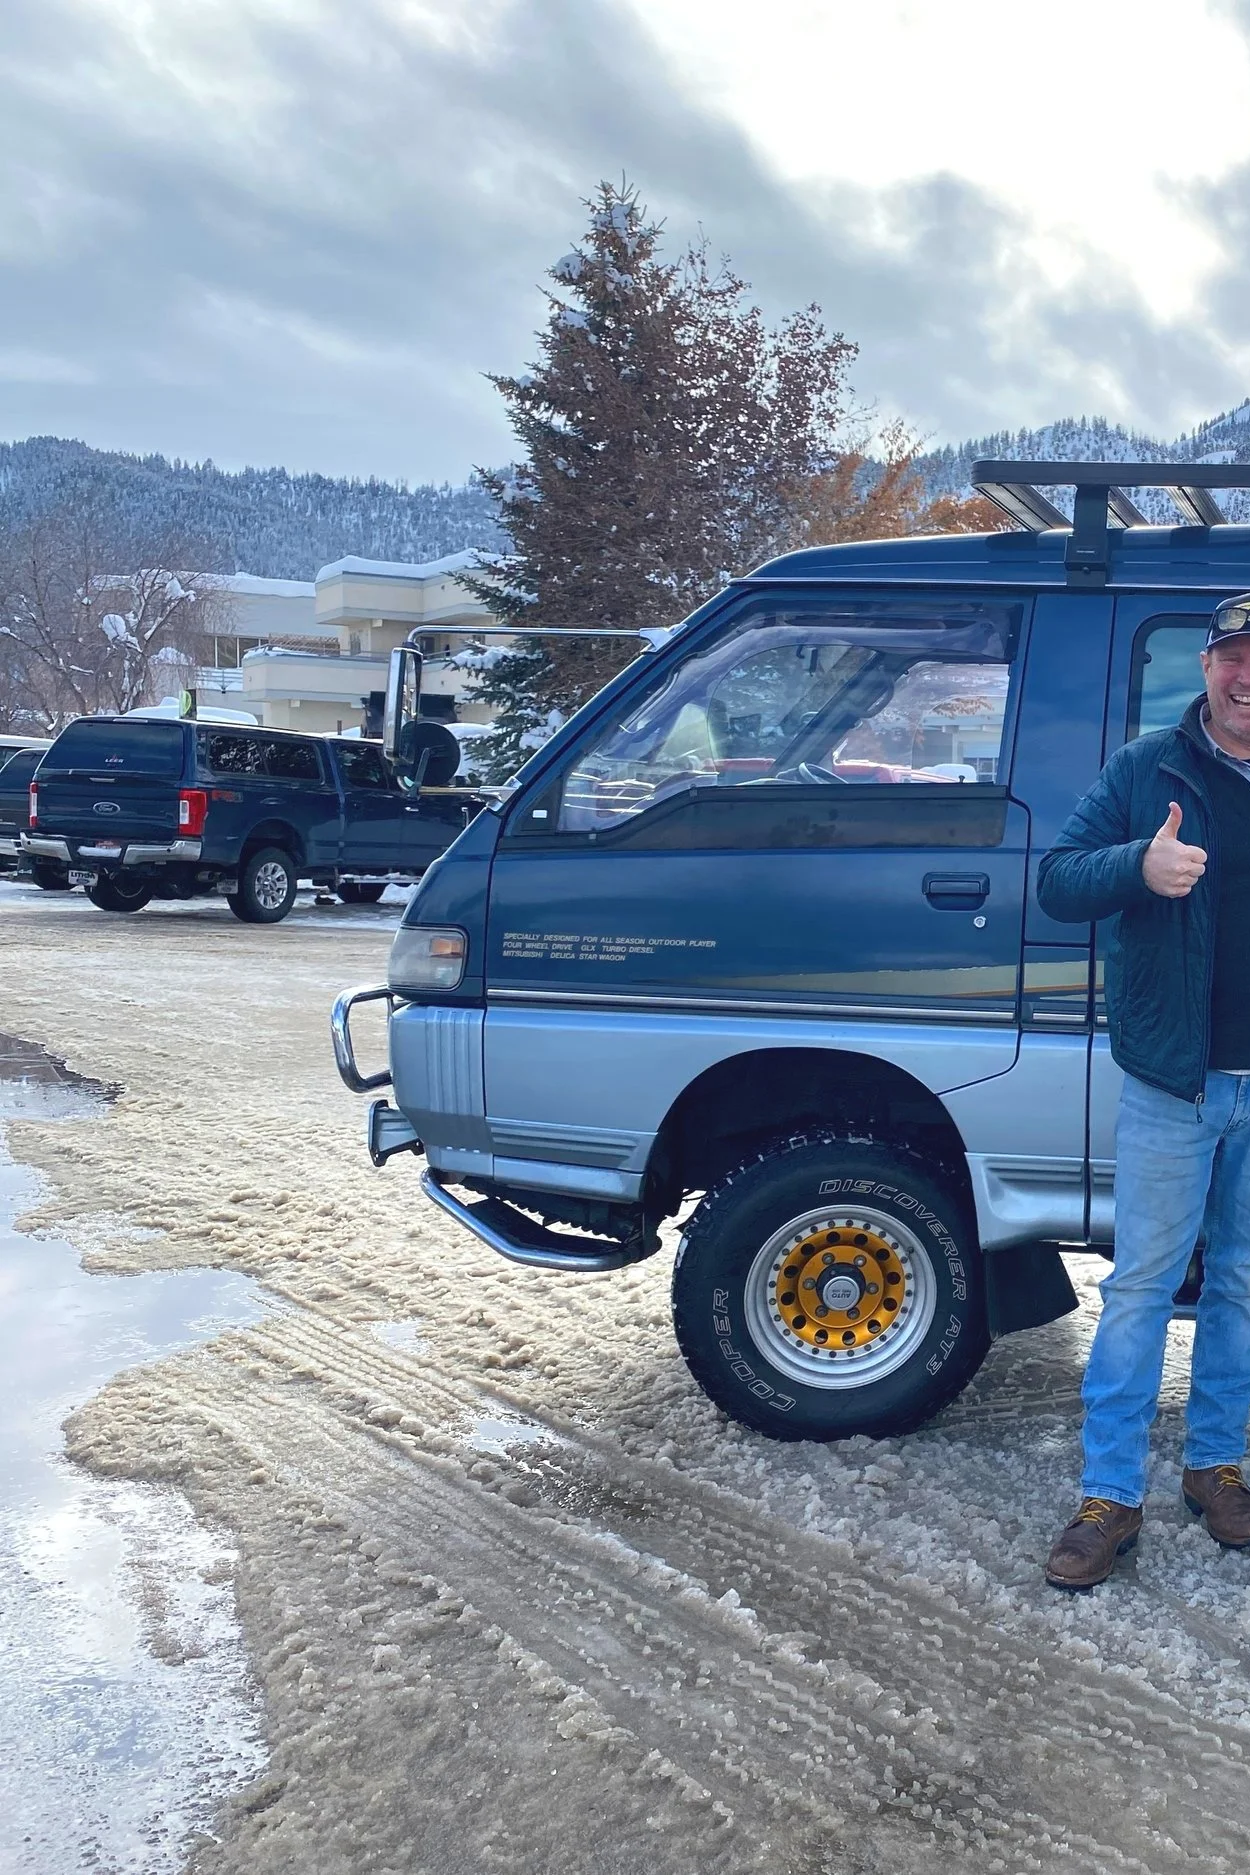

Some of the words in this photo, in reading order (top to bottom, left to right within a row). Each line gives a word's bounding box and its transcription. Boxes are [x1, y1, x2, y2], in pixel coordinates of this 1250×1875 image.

[502, 941, 522, 949] FOUR
[525, 942, 550, 950] WHEEL
[551, 943, 573, 951] DRIVE
[580, 944, 596, 952] GLX
[601, 945, 627, 953] TURBO
[628, 946, 656, 954] DIESEL
[503, 932, 540, 941] SPECIALLY
[543, 934, 580, 943] DESIGNED
[582, 935, 598, 944] FOR
[615, 937, 646, 946] SEASON
[648, 938, 687, 947] OUTDOOR
[688, 940, 717, 948] PLAYER
[502, 950, 544, 958] MITSUBISHI
[549, 952, 576, 960] DELICA
[578, 953, 598, 961] STAR
[598, 953, 626, 961] WAGON
[818, 1178, 968, 1301] DISCOVERER
[926, 1313, 963, 1376] AT3
[713, 1288, 797, 1413] COOPER
